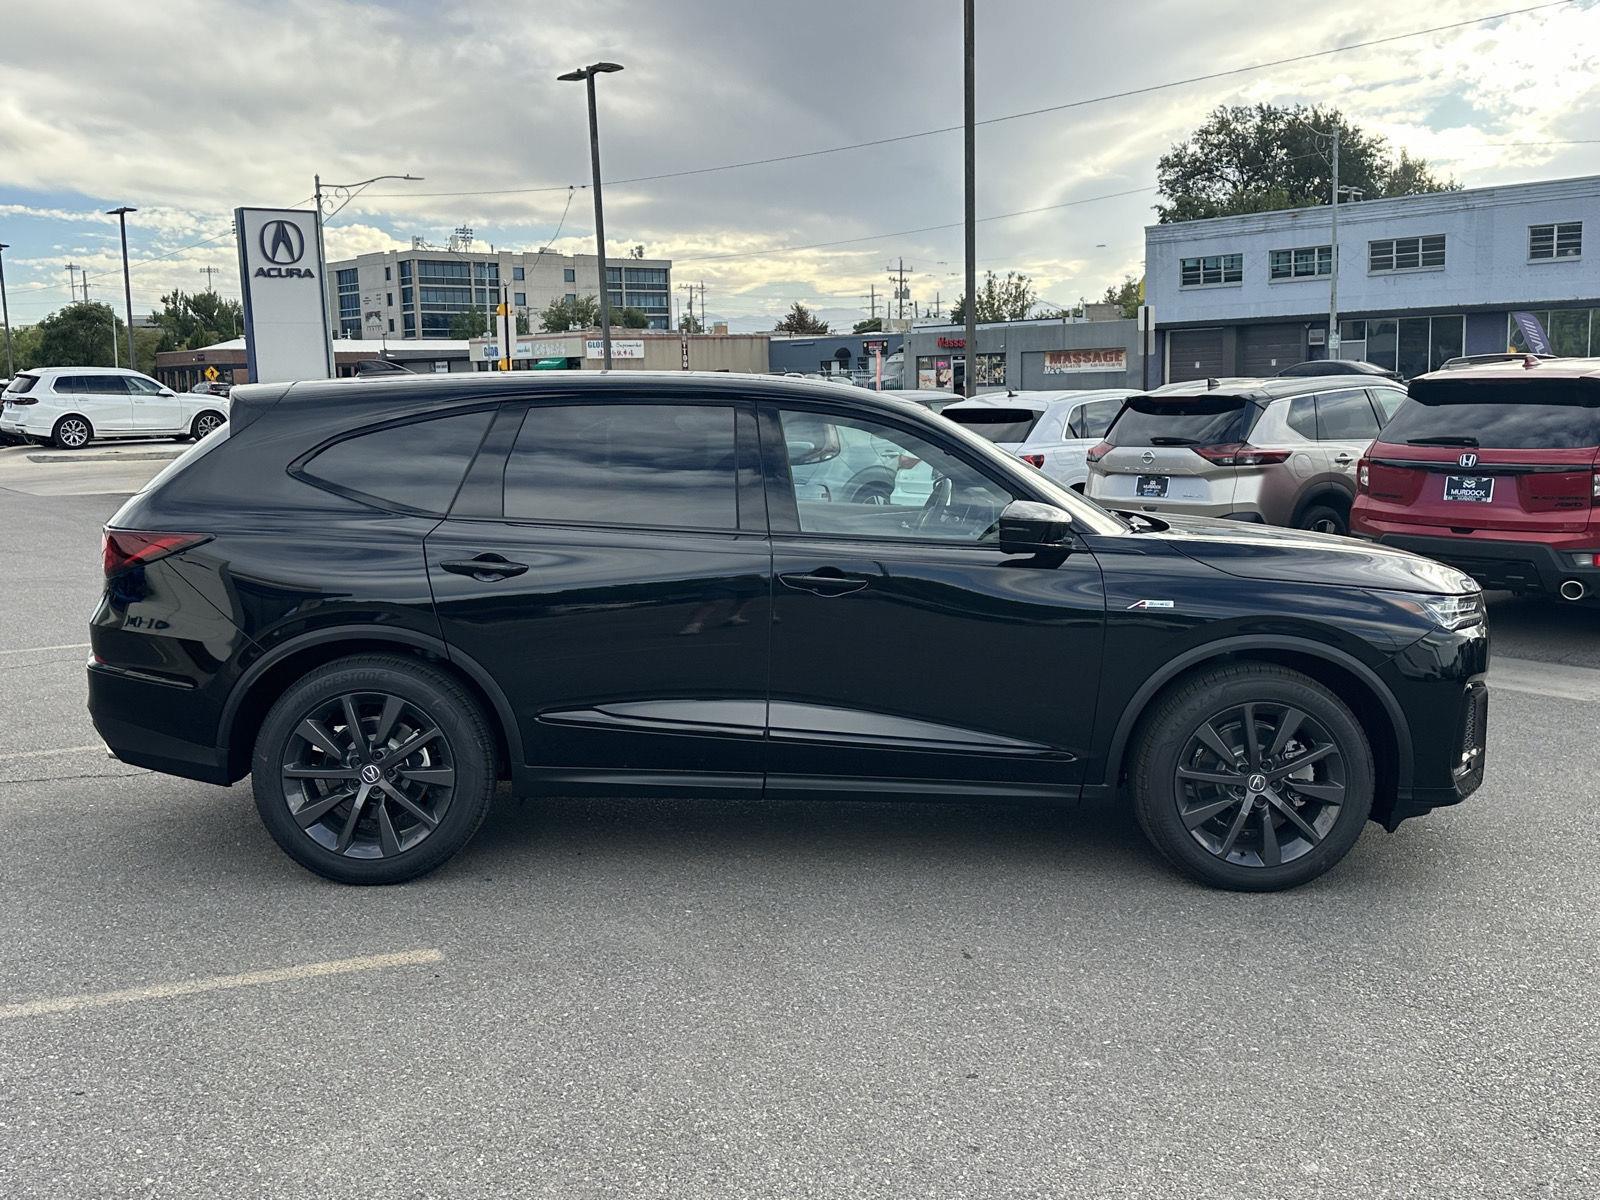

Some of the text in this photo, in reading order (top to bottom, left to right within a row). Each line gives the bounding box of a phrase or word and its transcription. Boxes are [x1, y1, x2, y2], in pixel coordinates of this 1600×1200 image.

[254, 267, 315, 278] ACURA
[937, 337, 967, 348] Massa
[1048, 350, 1124, 365] MASSAGE
